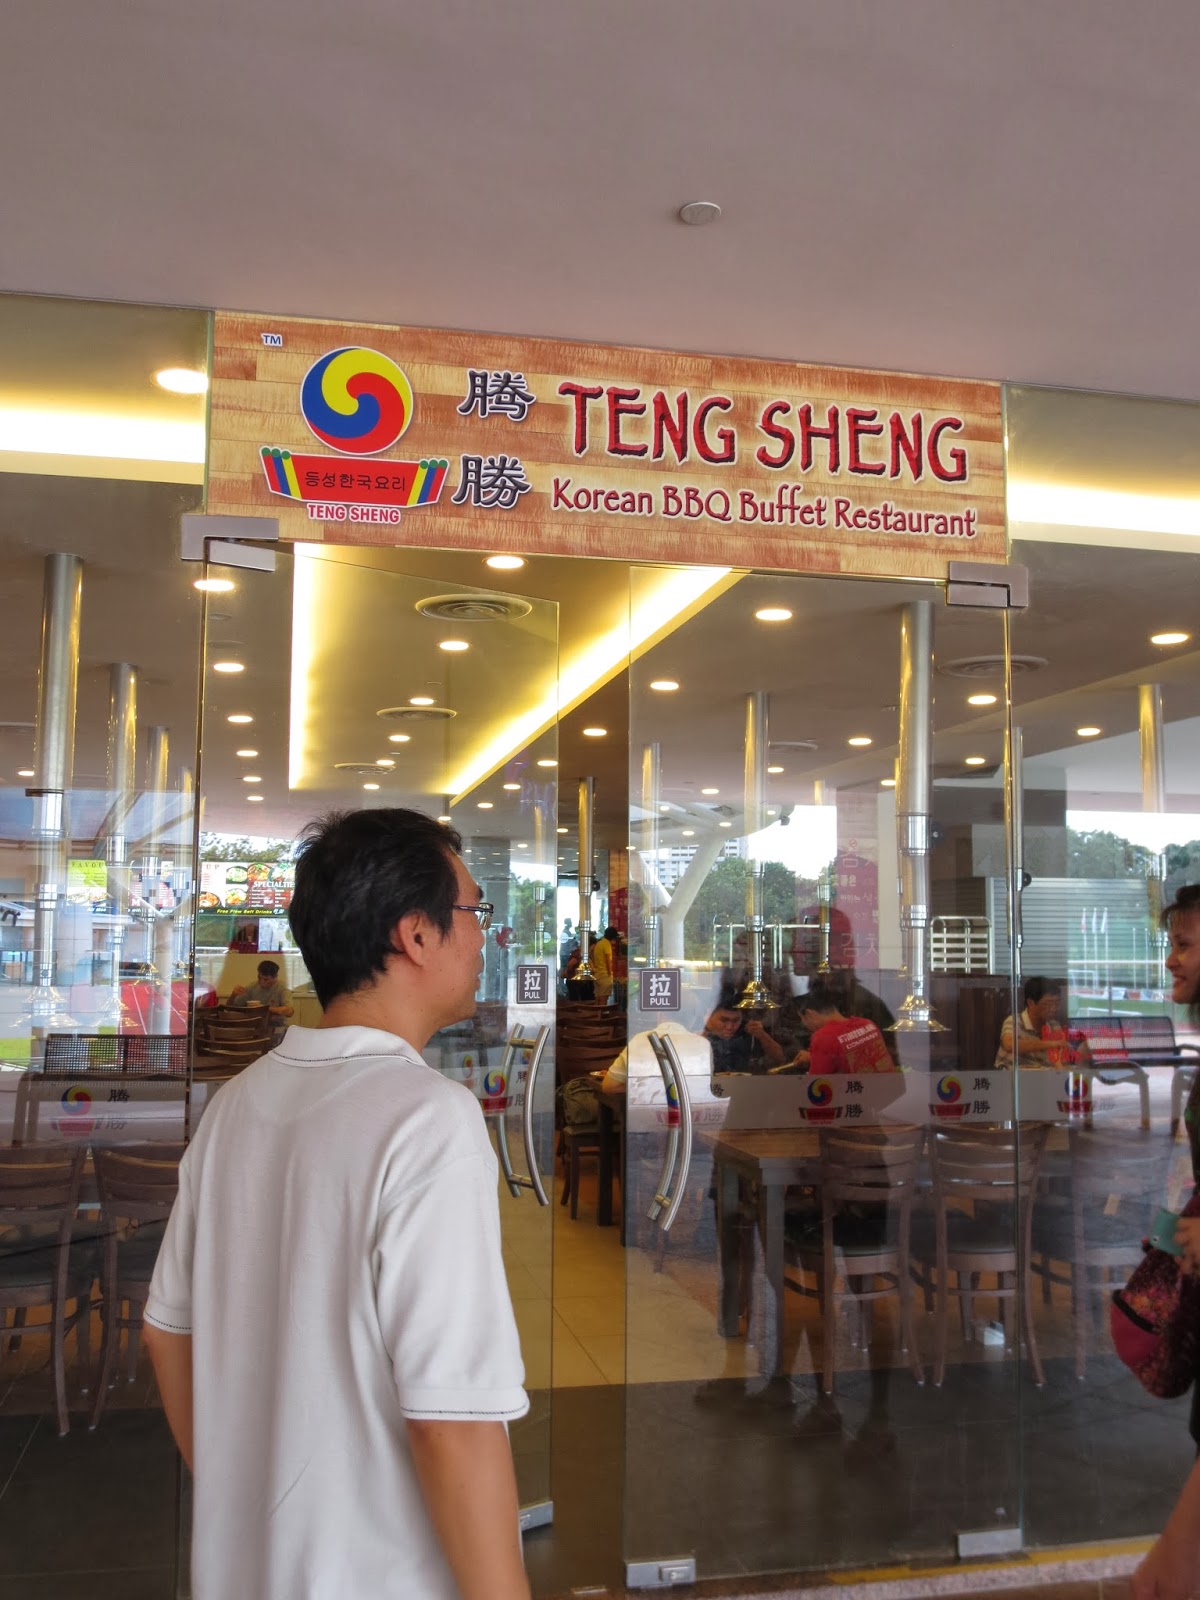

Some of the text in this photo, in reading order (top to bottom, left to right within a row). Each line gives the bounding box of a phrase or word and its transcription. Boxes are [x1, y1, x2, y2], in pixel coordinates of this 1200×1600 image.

[263, 334, 282, 345] TM
[558, 381, 968, 483] TENG SHENG
[304, 471, 406, 492] 등성한국요리
[308, 504, 400, 523] TENG SHENG
[552, 477, 977, 538] Korean BBQ Buffet Restaurant
[524, 969, 541, 991] 拉
[650, 974, 671, 996] 拉
[650, 998, 671, 1006] PULL
